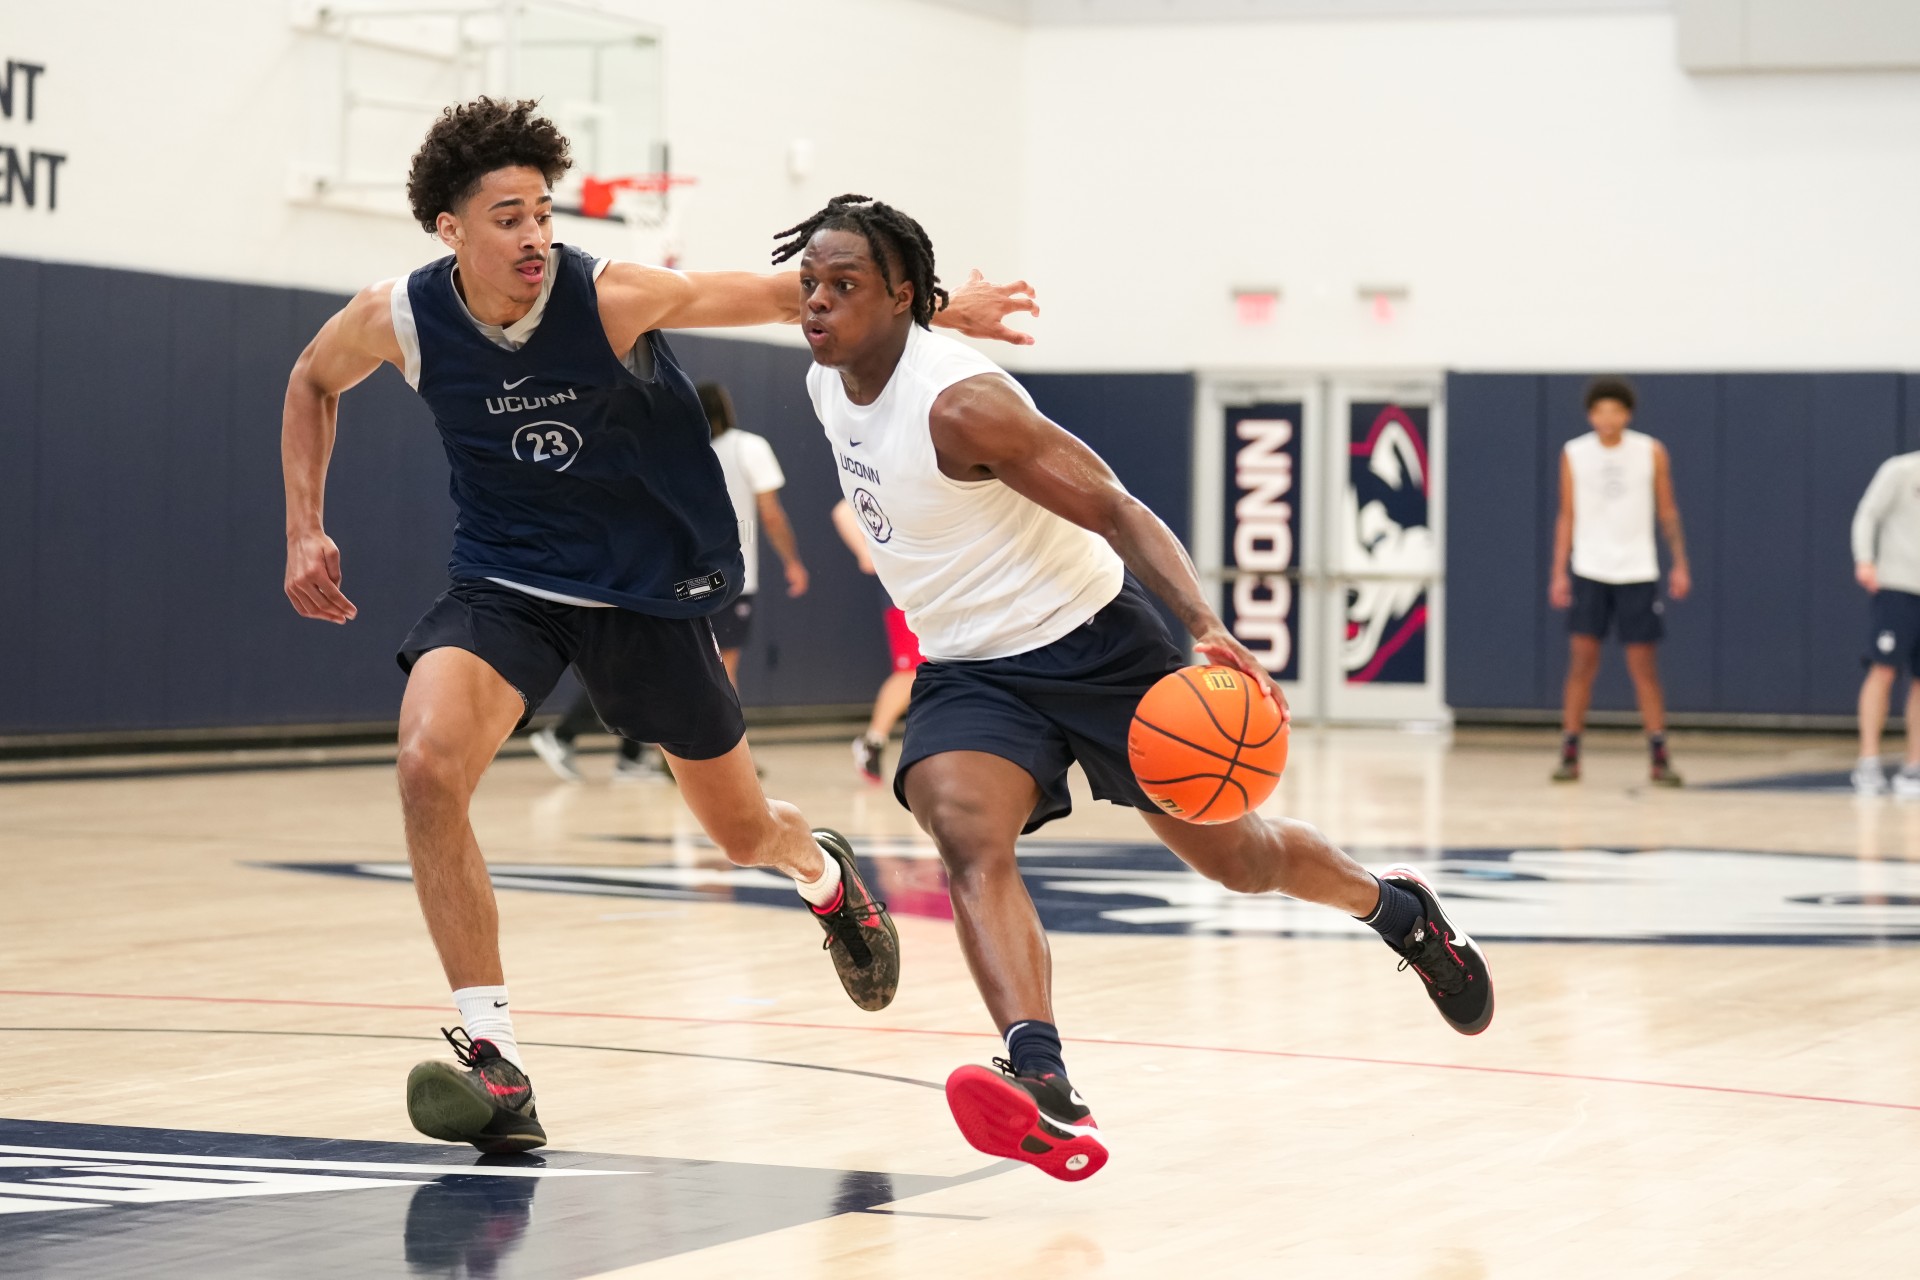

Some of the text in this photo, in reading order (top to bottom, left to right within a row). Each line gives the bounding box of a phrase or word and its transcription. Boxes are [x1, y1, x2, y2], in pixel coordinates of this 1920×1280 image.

[526, 430, 569, 463] 23
[840, 452, 881, 486] UCONN
[1233, 418, 1293, 673] UCONN
[713, 577, 721, 585] L
